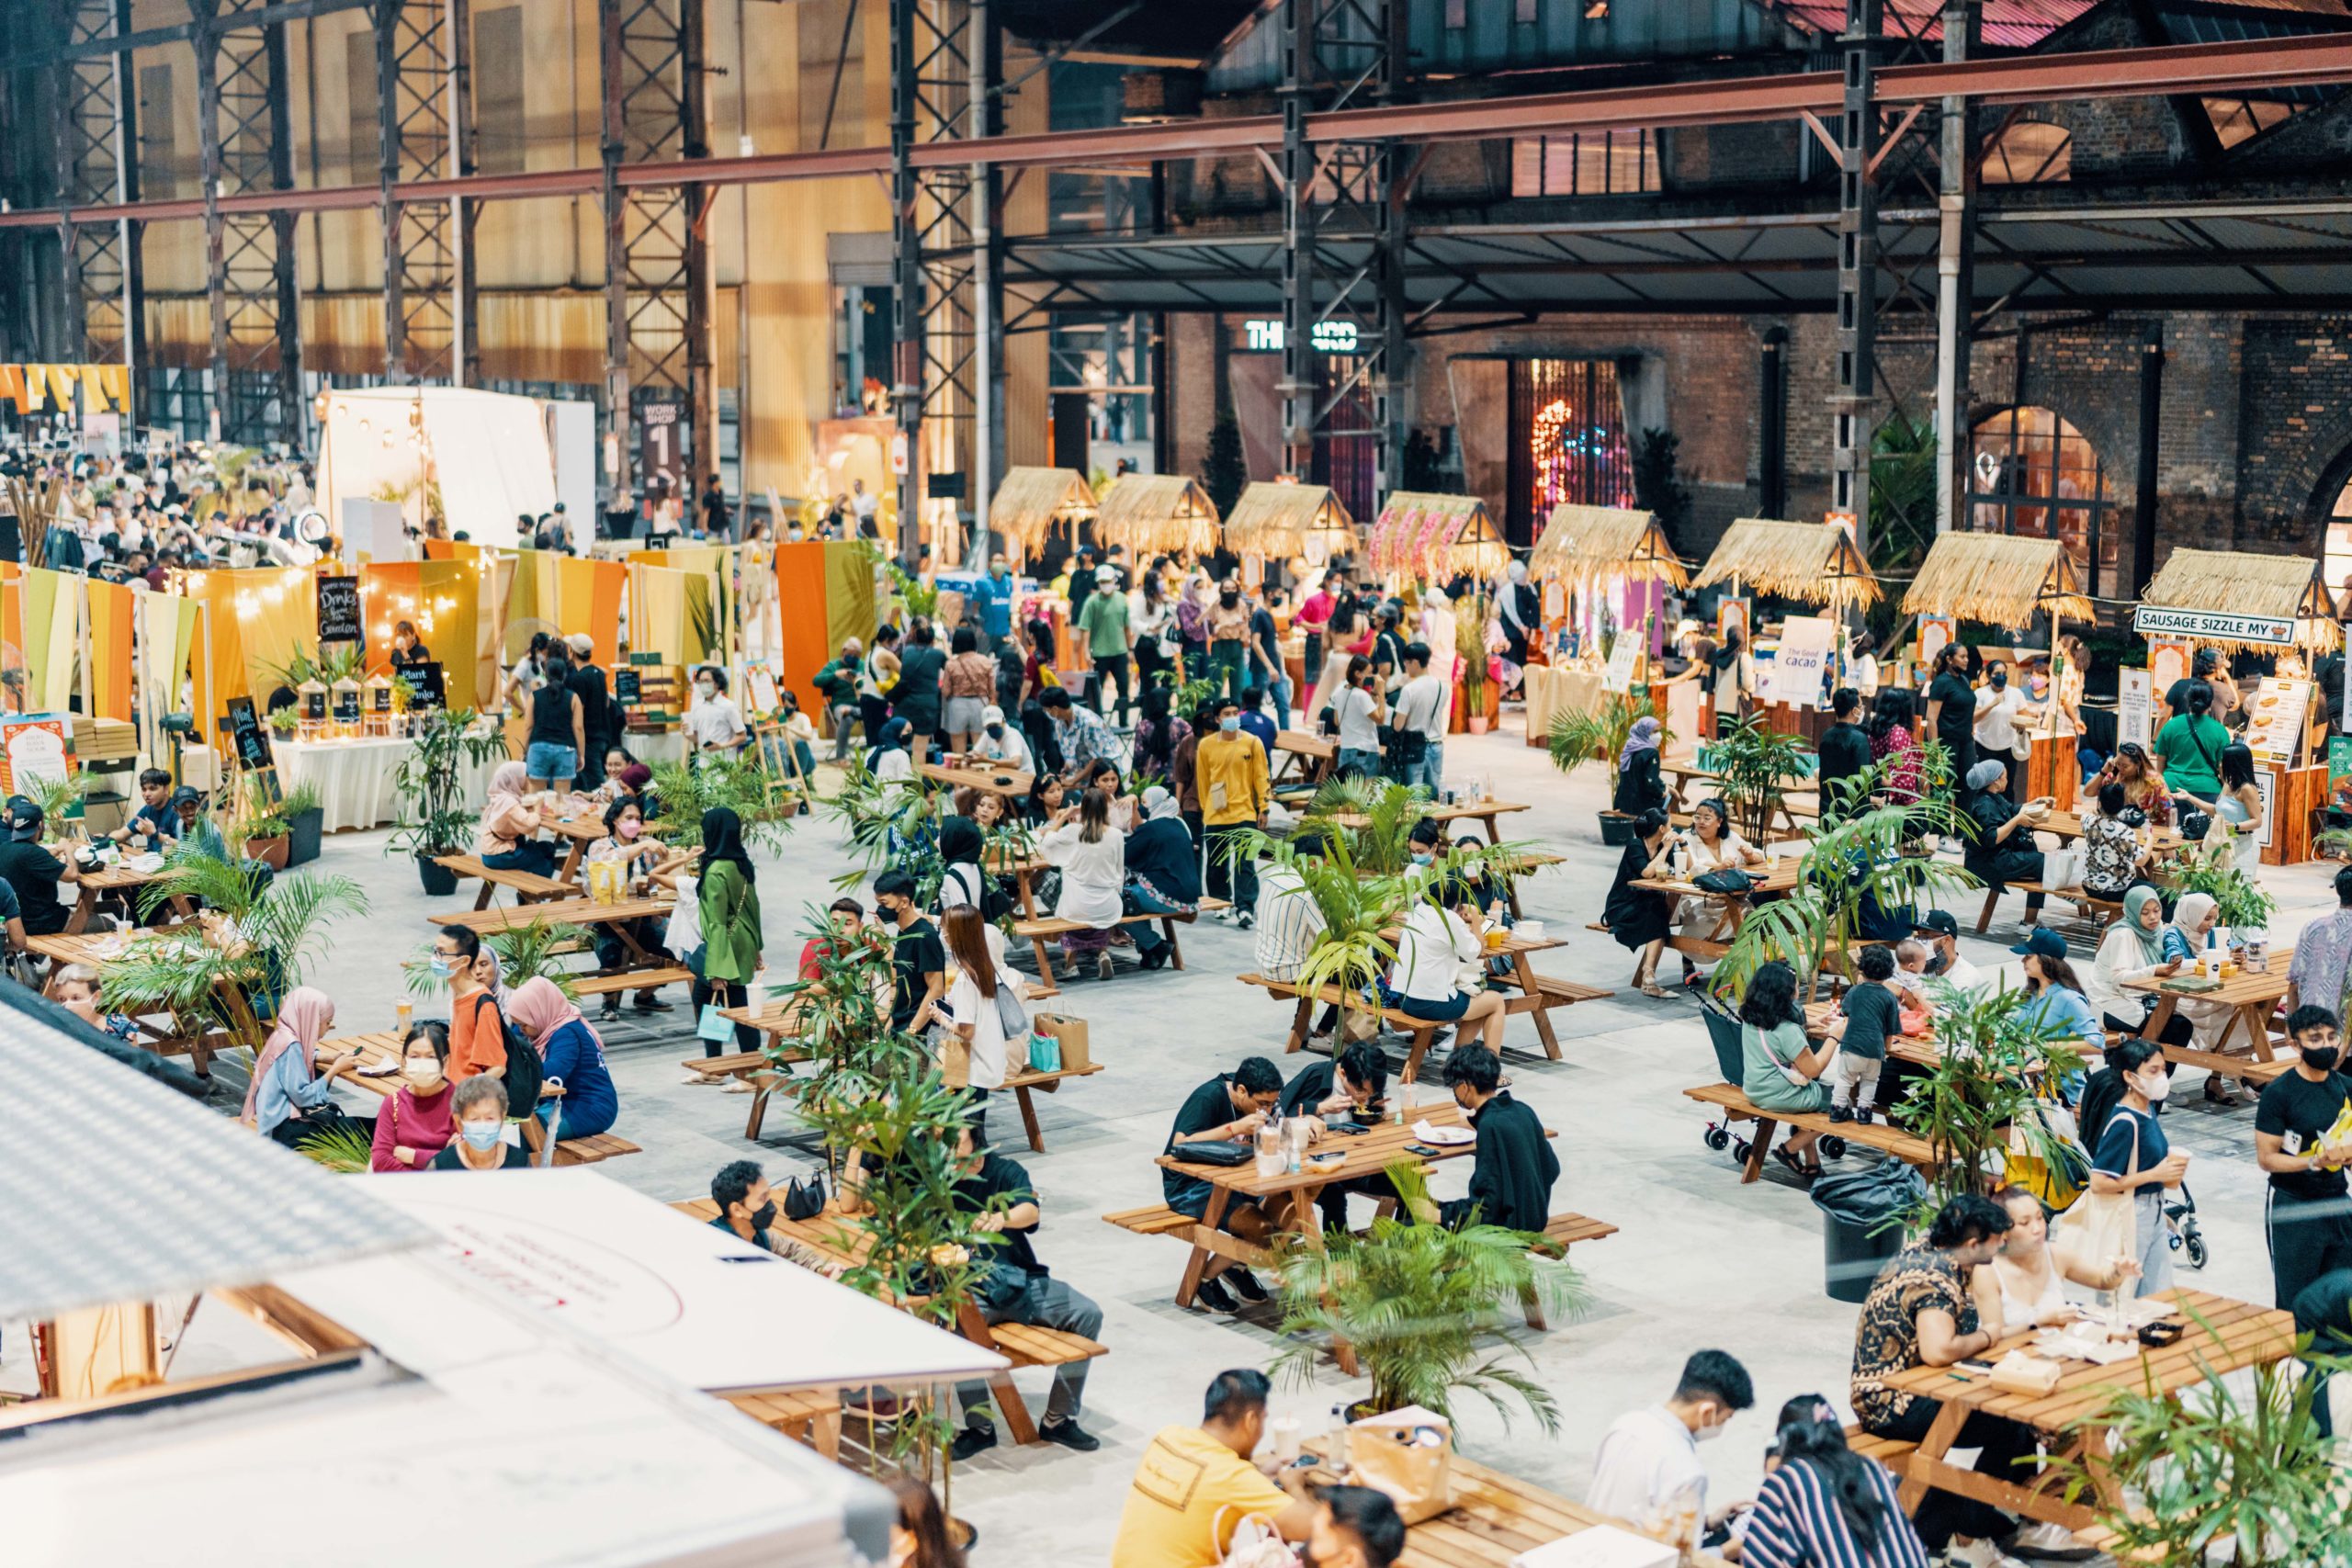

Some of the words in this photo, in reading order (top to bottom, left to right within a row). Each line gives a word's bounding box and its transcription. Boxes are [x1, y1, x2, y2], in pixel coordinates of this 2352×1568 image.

[645, 404, 677, 414] WORK
[646, 414, 676, 424] SHOP
[650, 425, 669, 466] 1
[2142, 613, 2198, 629] SAUSAGE
[2201, 618, 2244, 633] SIZZLE
[2247, 623, 2269, 636] MY
[1802, 649, 1819, 658] Good
[1785, 657, 1816, 669] cacao
[402, 670, 427, 679] Plant
